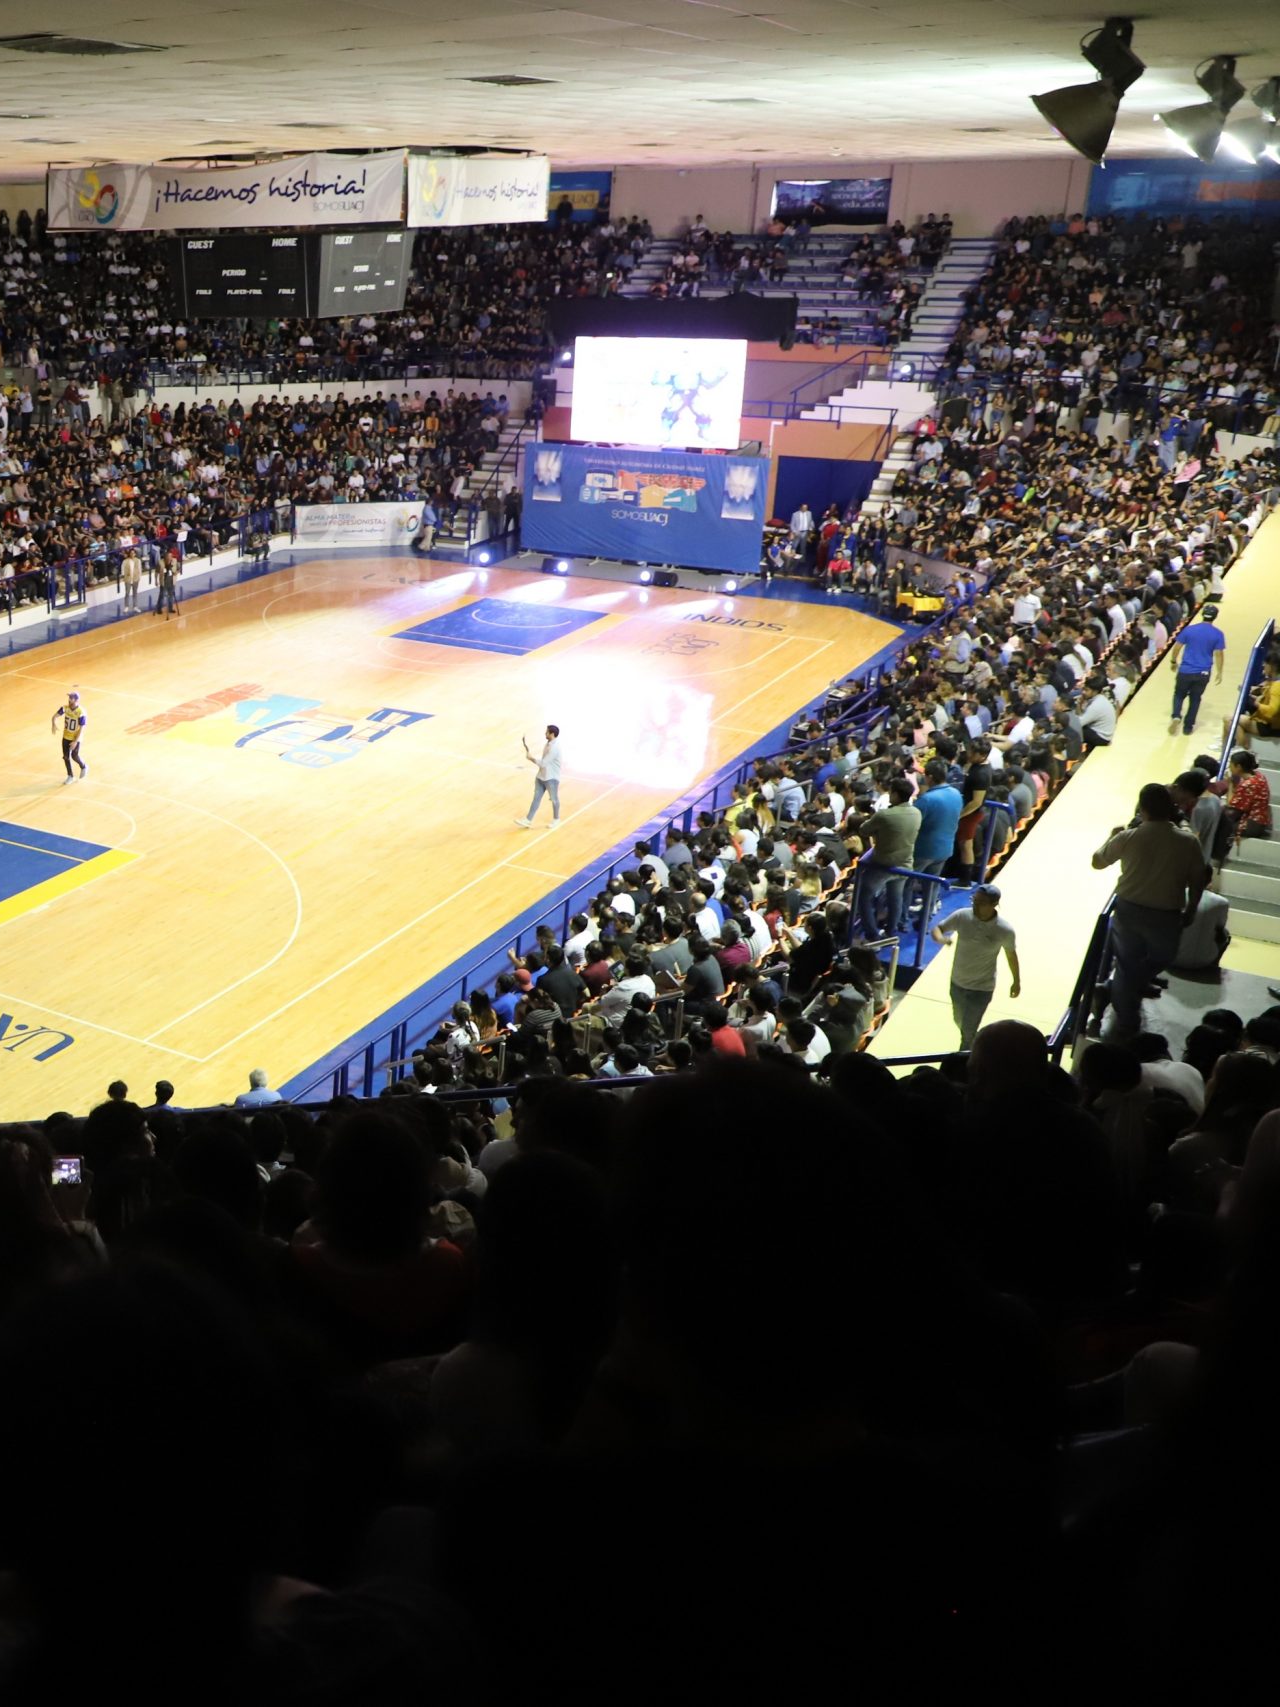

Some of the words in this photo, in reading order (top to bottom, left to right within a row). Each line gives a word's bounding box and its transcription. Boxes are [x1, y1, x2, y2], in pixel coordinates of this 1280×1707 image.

[155, 179, 260, 213] ¡Hacemos
[268, 169, 367, 202] historia!
[187, 239, 215, 250] GUEST
[272, 237, 299, 248] HOME
[222, 268, 247, 277] PERIOD
[683, 613, 787, 632] INDIOS
